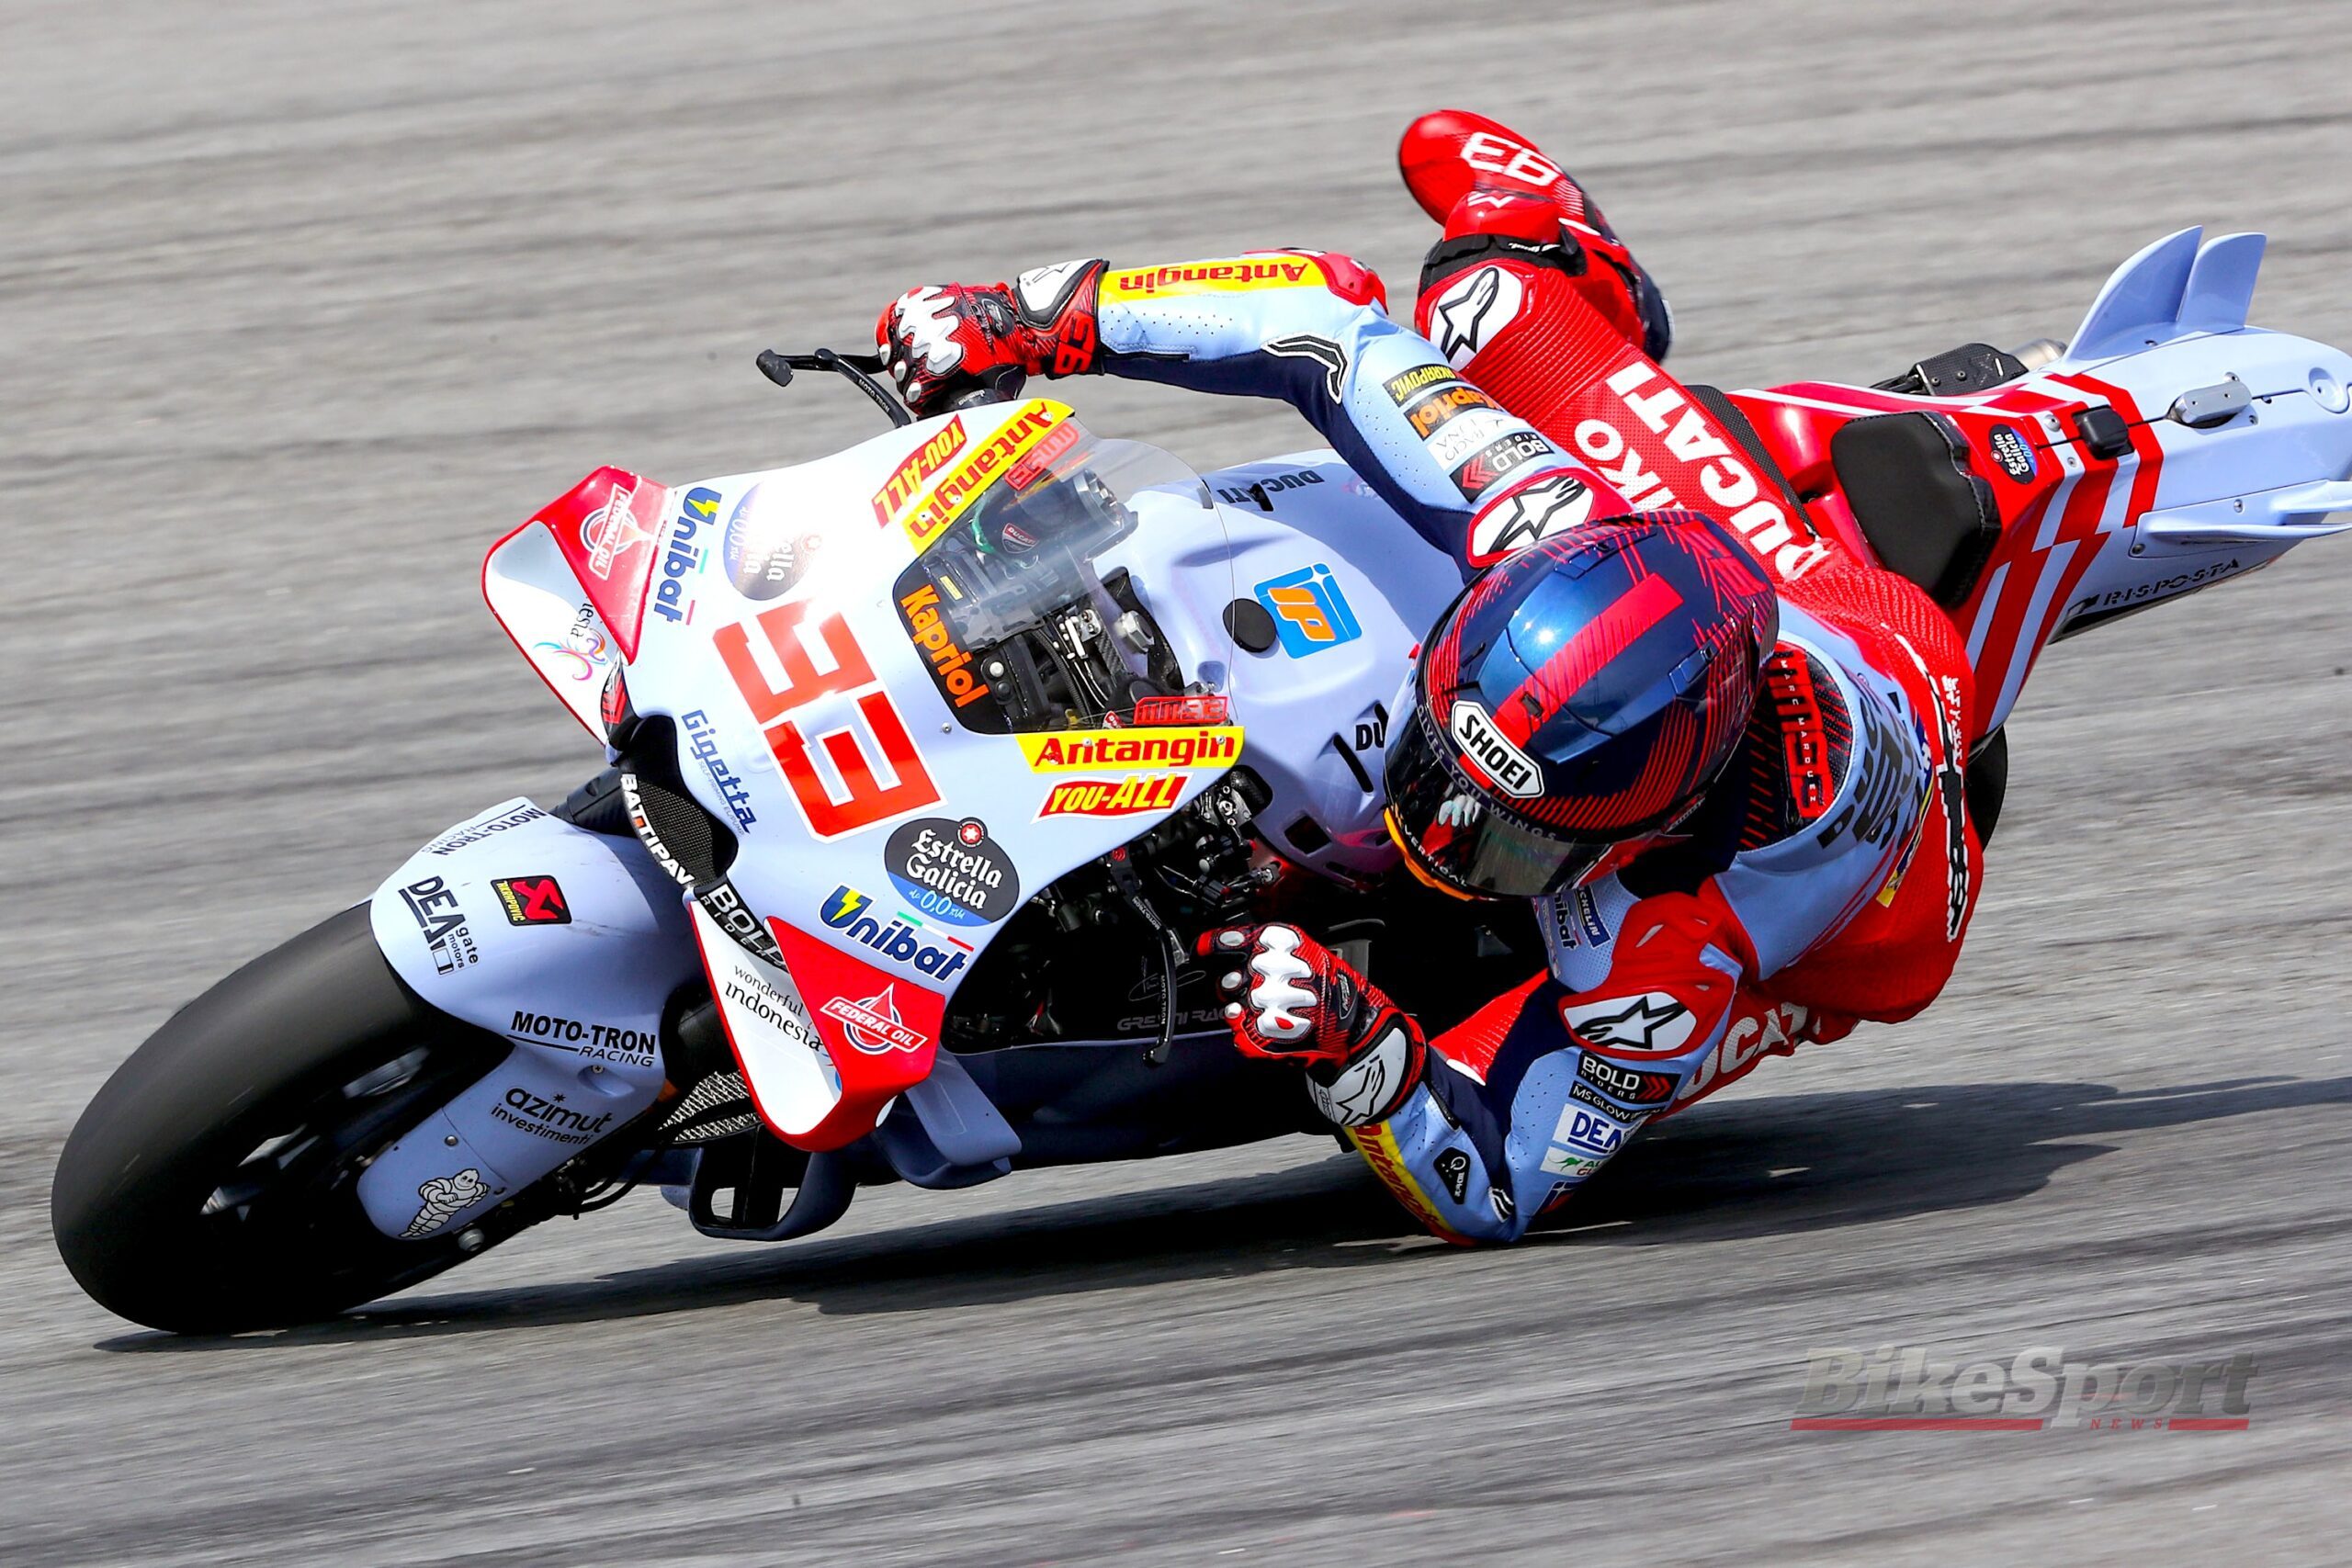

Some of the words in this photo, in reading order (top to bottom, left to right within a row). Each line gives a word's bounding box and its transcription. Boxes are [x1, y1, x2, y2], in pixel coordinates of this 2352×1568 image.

[1120, 263, 1308, 293] Antangin
[874, 421, 966, 524] YOU-ALL
[910, 402, 1053, 537] Antangin
[1492, 439, 1549, 471] BOLD
[1575, 418, 1686, 511] IKO
[1605, 360, 1830, 582] DUCATI
[595, 541, 612, 570] OIL
[654, 487, 722, 622] Unibat
[900, 584, 989, 708] Kapriol
[682, 709, 757, 834] Gigetta
[1035, 730, 1234, 766] Antangin
[1459, 714, 1532, 790] SHOEI
[1048, 773, 1179, 812] YOU-ALL
[432, 807, 548, 856] MOTO-TRON
[621, 773, 695, 885] BATTIPAV
[907, 852, 987, 909] Galicia
[911, 829, 1002, 888] Estrella
[820, 885, 967, 981] Unibat
[1580, 888, 1600, 936] CHELIN
[447, 933, 465, 969] motors
[456, 926, 479, 964] gate
[735, 964, 804, 1017] wonderful
[511, 1010, 657, 1055] MOTO-TRON
[830, 999, 891, 1035] FEDERAL
[890, 1028, 918, 1047] OIL
[579, 1045, 655, 1067] RACING
[1582, 1056, 1640, 1090] BOLD
[1573, 1086, 1592, 1100] MS
[1592, 1095, 1631, 1121] GLOW
[1580, 1069, 1636, 1100] RIDERS
[491, 1103, 594, 1145] investimenti
[505, 1088, 614, 1133] azimut
